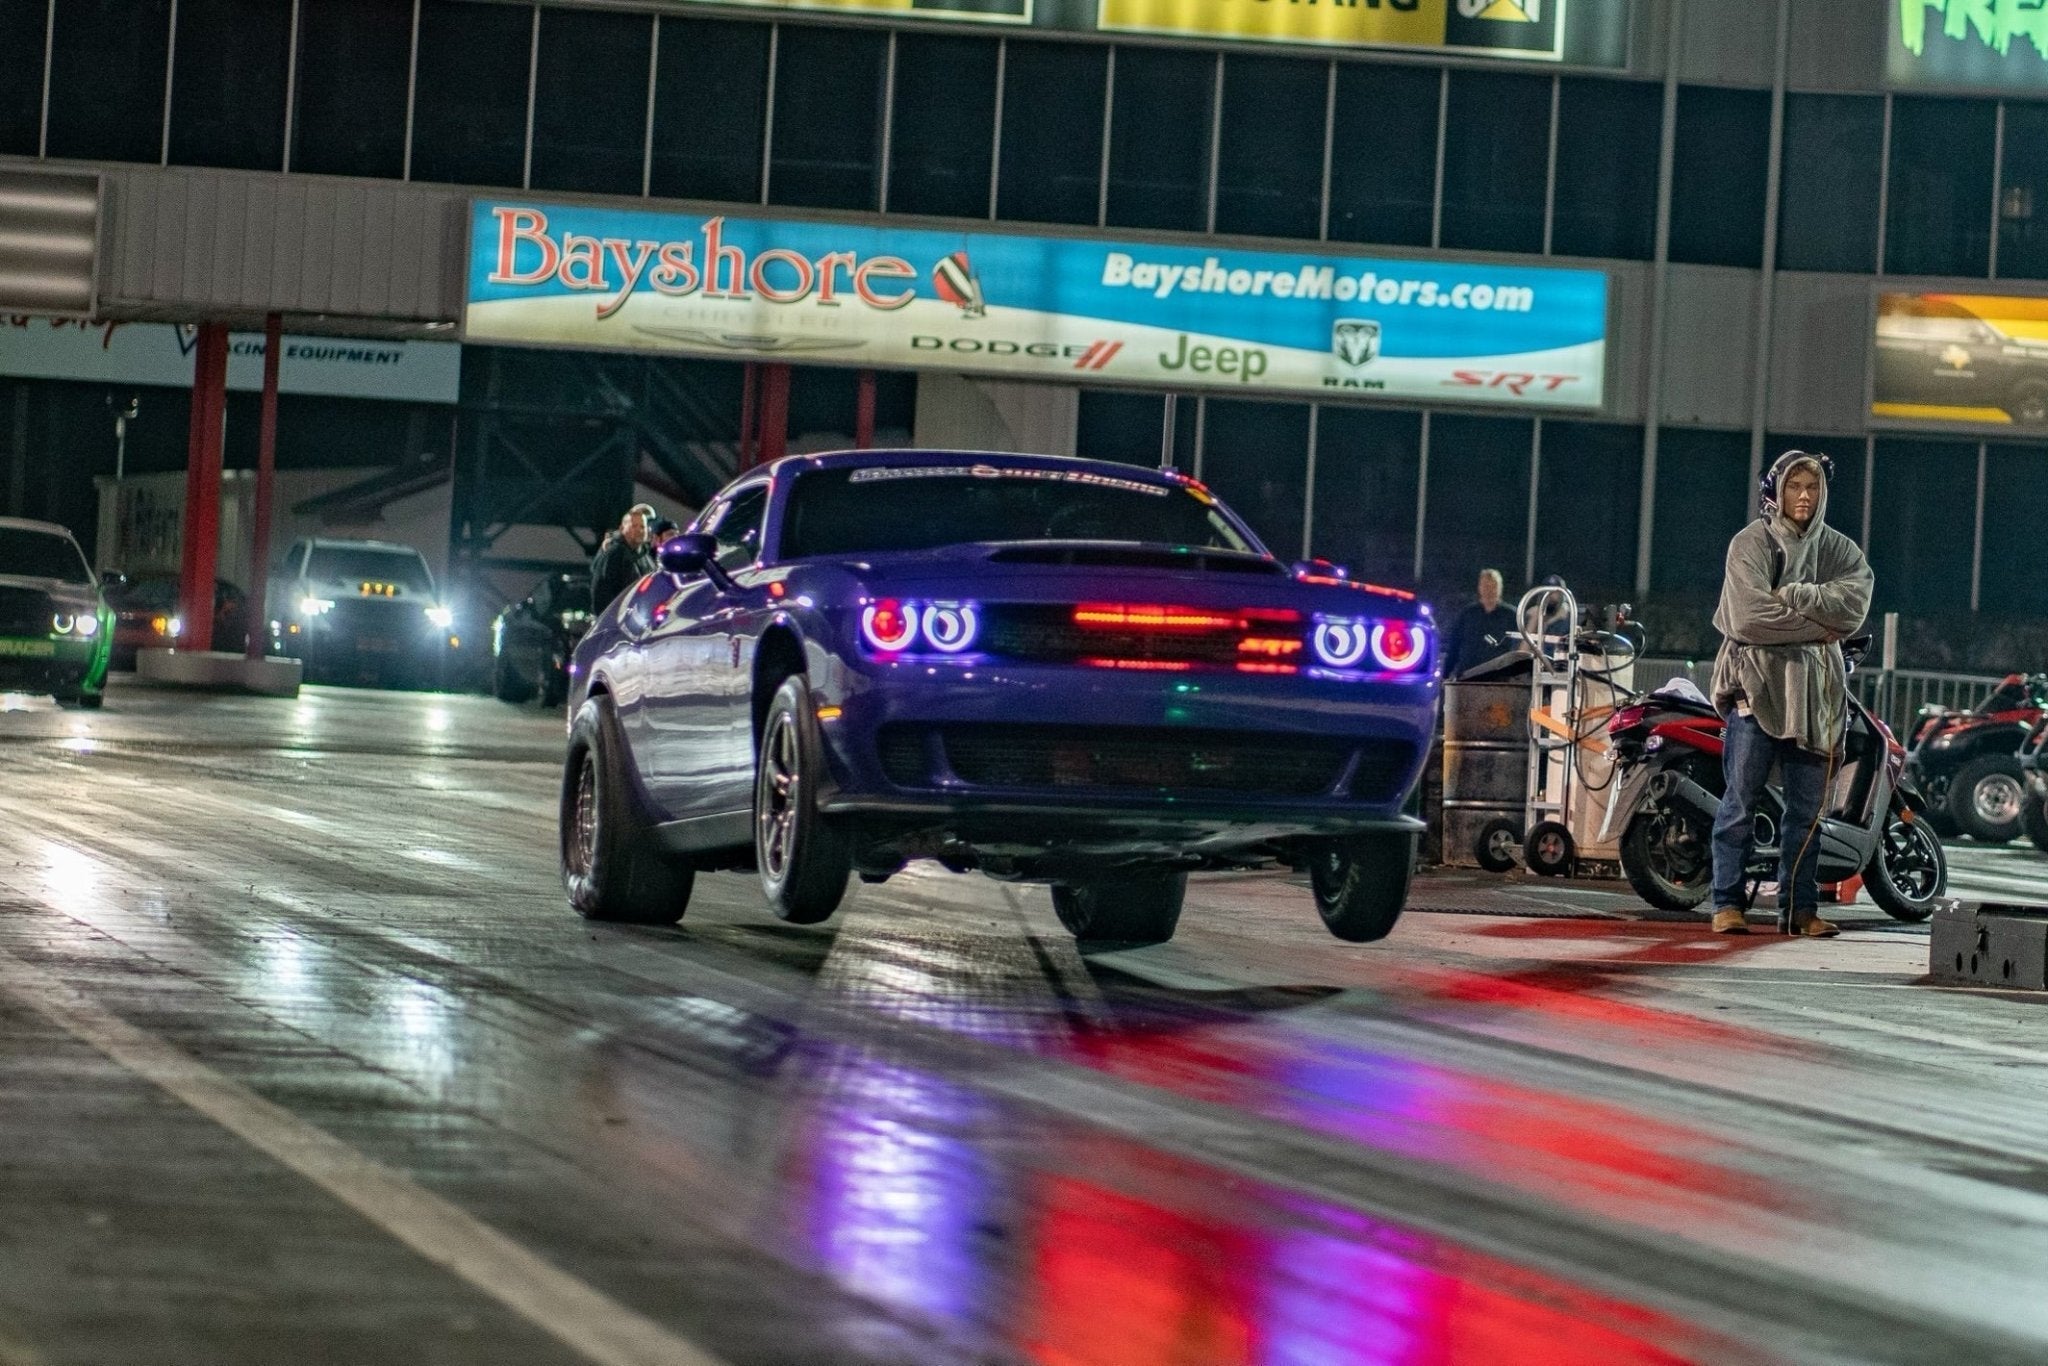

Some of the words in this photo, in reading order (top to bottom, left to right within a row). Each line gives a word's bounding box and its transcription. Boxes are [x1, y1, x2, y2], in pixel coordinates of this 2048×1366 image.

[488, 206, 917, 320] Bayshore
[1102, 252, 1534, 312] BayshoreMotors.com
[286, 344, 403, 365] EQUIPMENT
[911, 335, 1091, 360] DODGE
[1159, 334, 1268, 381] Jeep
[1323, 376, 1385, 390] RAM
[1440, 369, 1580, 397] SRT
